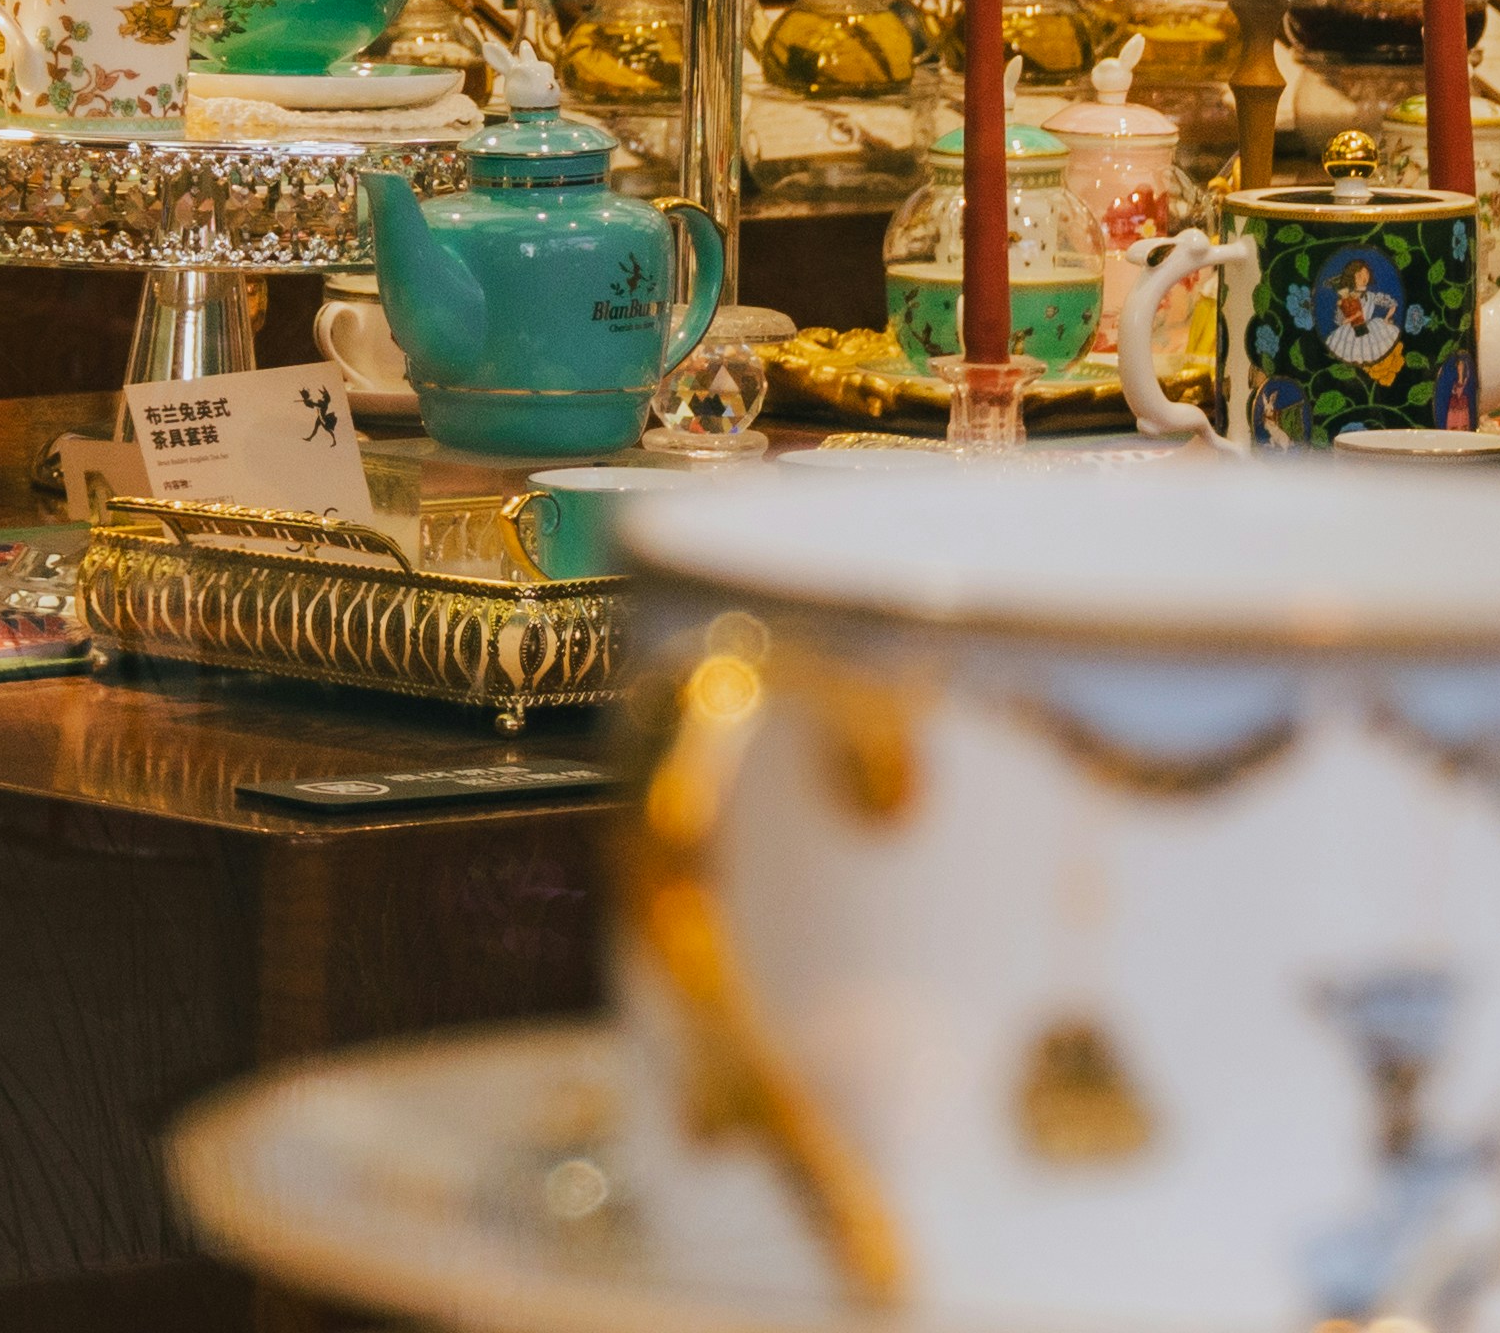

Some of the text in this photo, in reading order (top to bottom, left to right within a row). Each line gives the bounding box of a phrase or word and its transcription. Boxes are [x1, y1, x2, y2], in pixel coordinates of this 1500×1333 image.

[144, 397, 231, 425] 布兰兔英式
[150, 424, 220, 450] 茶具套装
